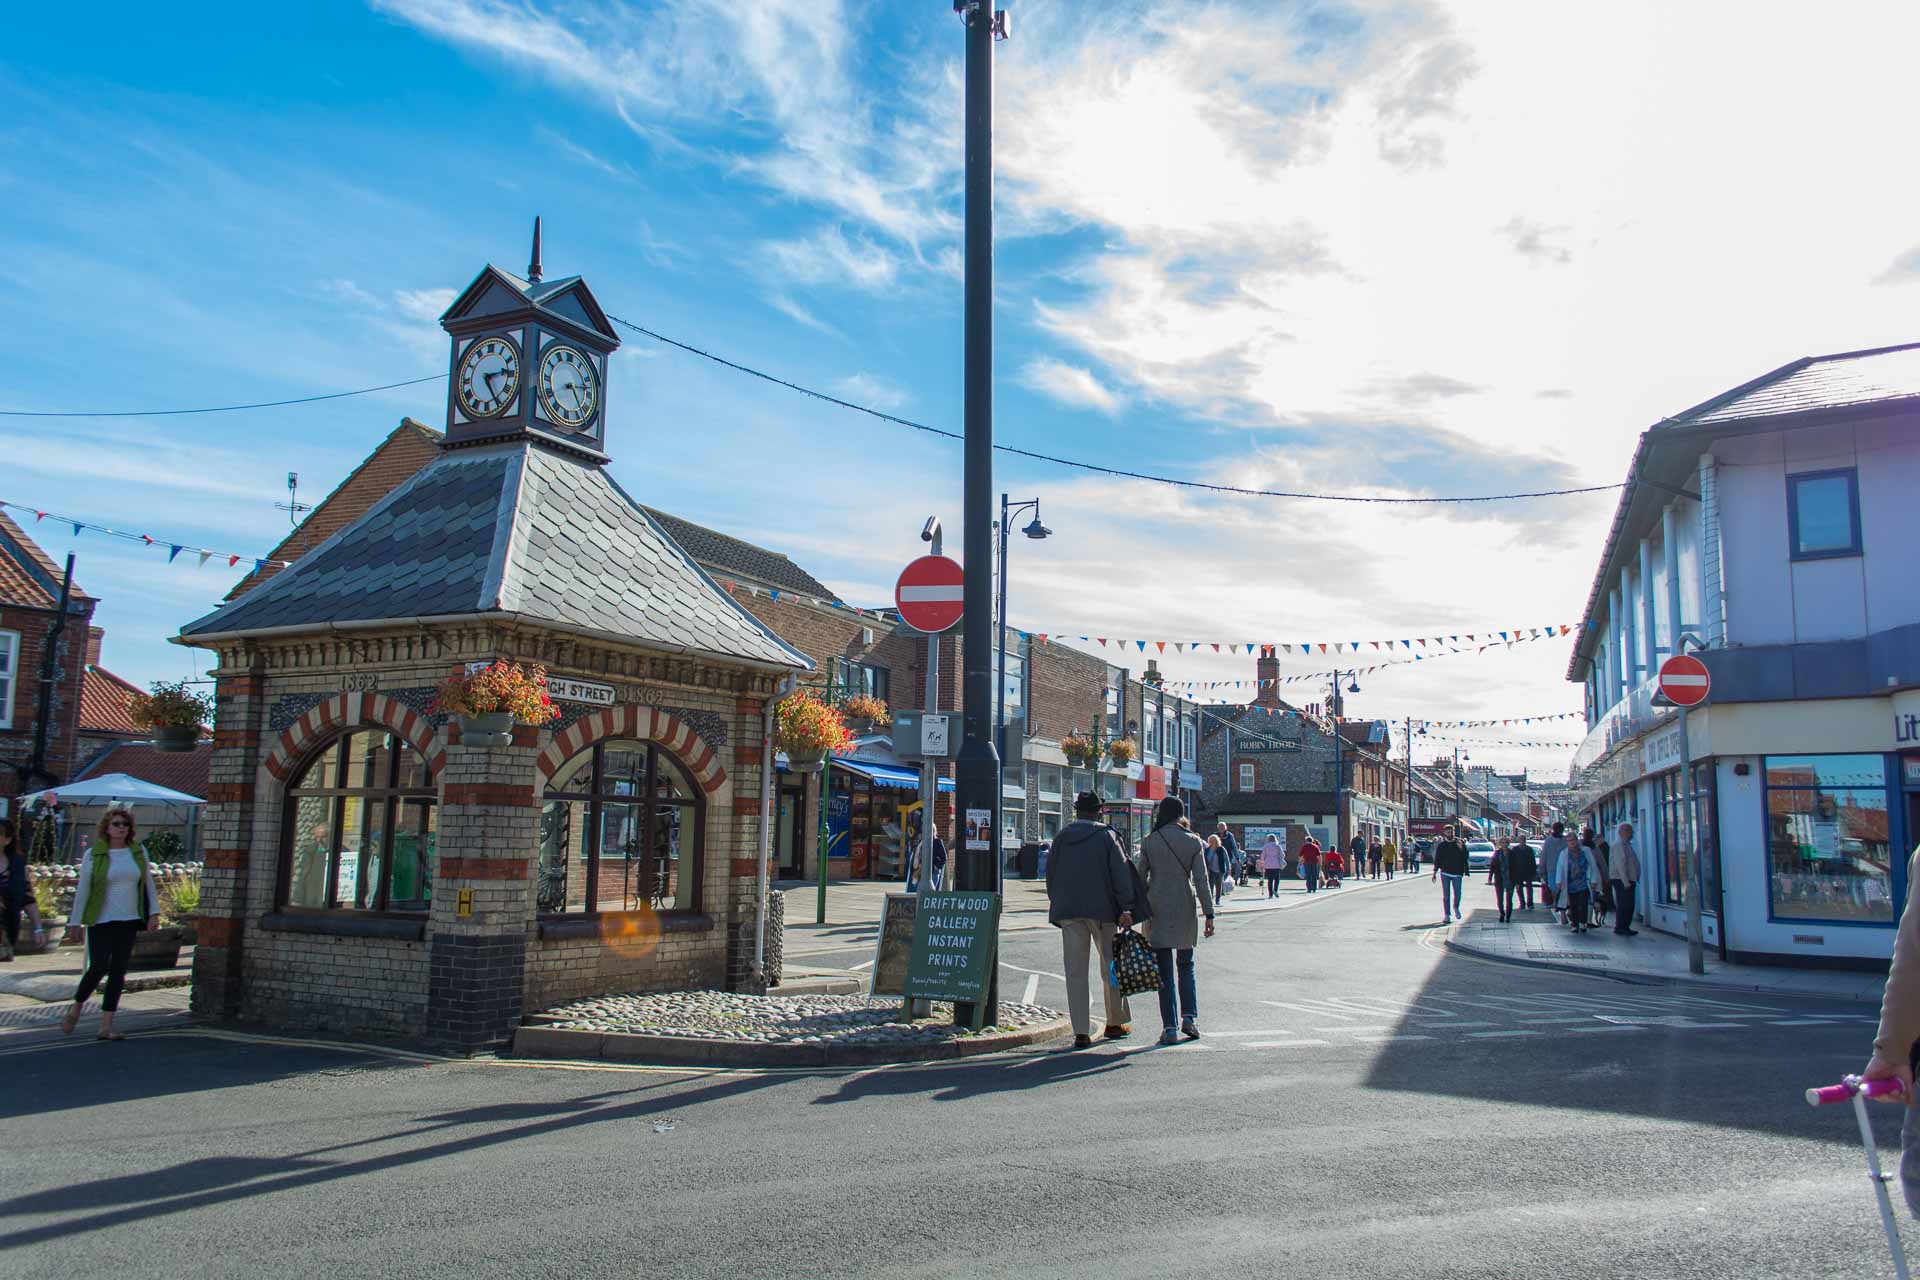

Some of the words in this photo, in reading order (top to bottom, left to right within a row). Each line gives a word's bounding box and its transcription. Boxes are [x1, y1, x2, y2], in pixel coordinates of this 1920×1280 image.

[546, 680, 566, 695] IGH
[570, 684, 614, 703] STREET
[624, 687, 663, 704] 1862
[1894, 714, 1920, 743] Lit
[1240, 741, 1265, 749] ROBIN
[1268, 741, 1295, 749] HOOD
[458, 891, 471, 914] H
[923, 897, 989, 911] DRIFTWOOD
[928, 916, 977, 929] GALLERY
[928, 934, 974, 948] INSTANT
[928, 953, 968, 968] PRINTS
